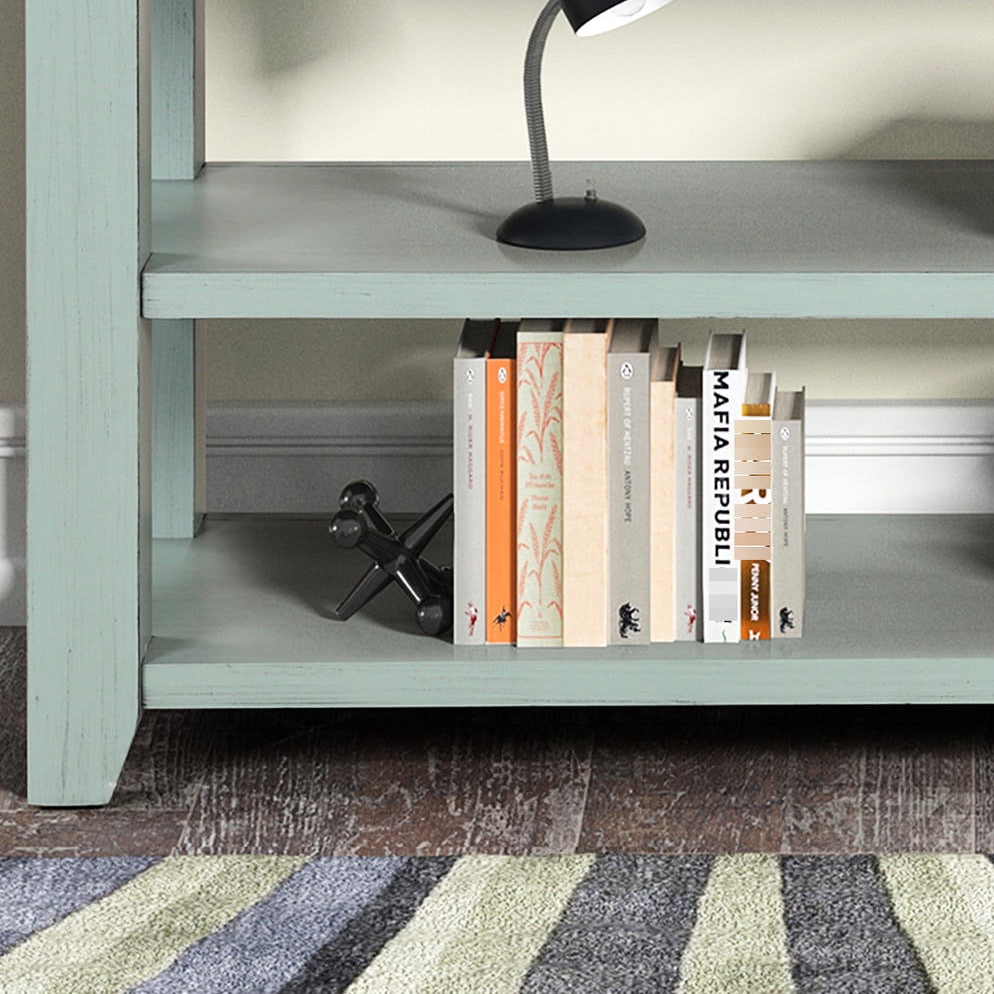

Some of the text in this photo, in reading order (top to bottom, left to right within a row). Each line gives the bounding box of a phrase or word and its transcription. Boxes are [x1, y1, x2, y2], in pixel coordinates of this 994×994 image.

[624, 387, 632, 416] RUPERT
[714, 371, 731, 566] MAFIA REPUBLI
[624, 470, 632, 500] ANTONY
[624, 502, 632, 523] HOPE
[750, 562, 760, 621] PENNY JUNOR
